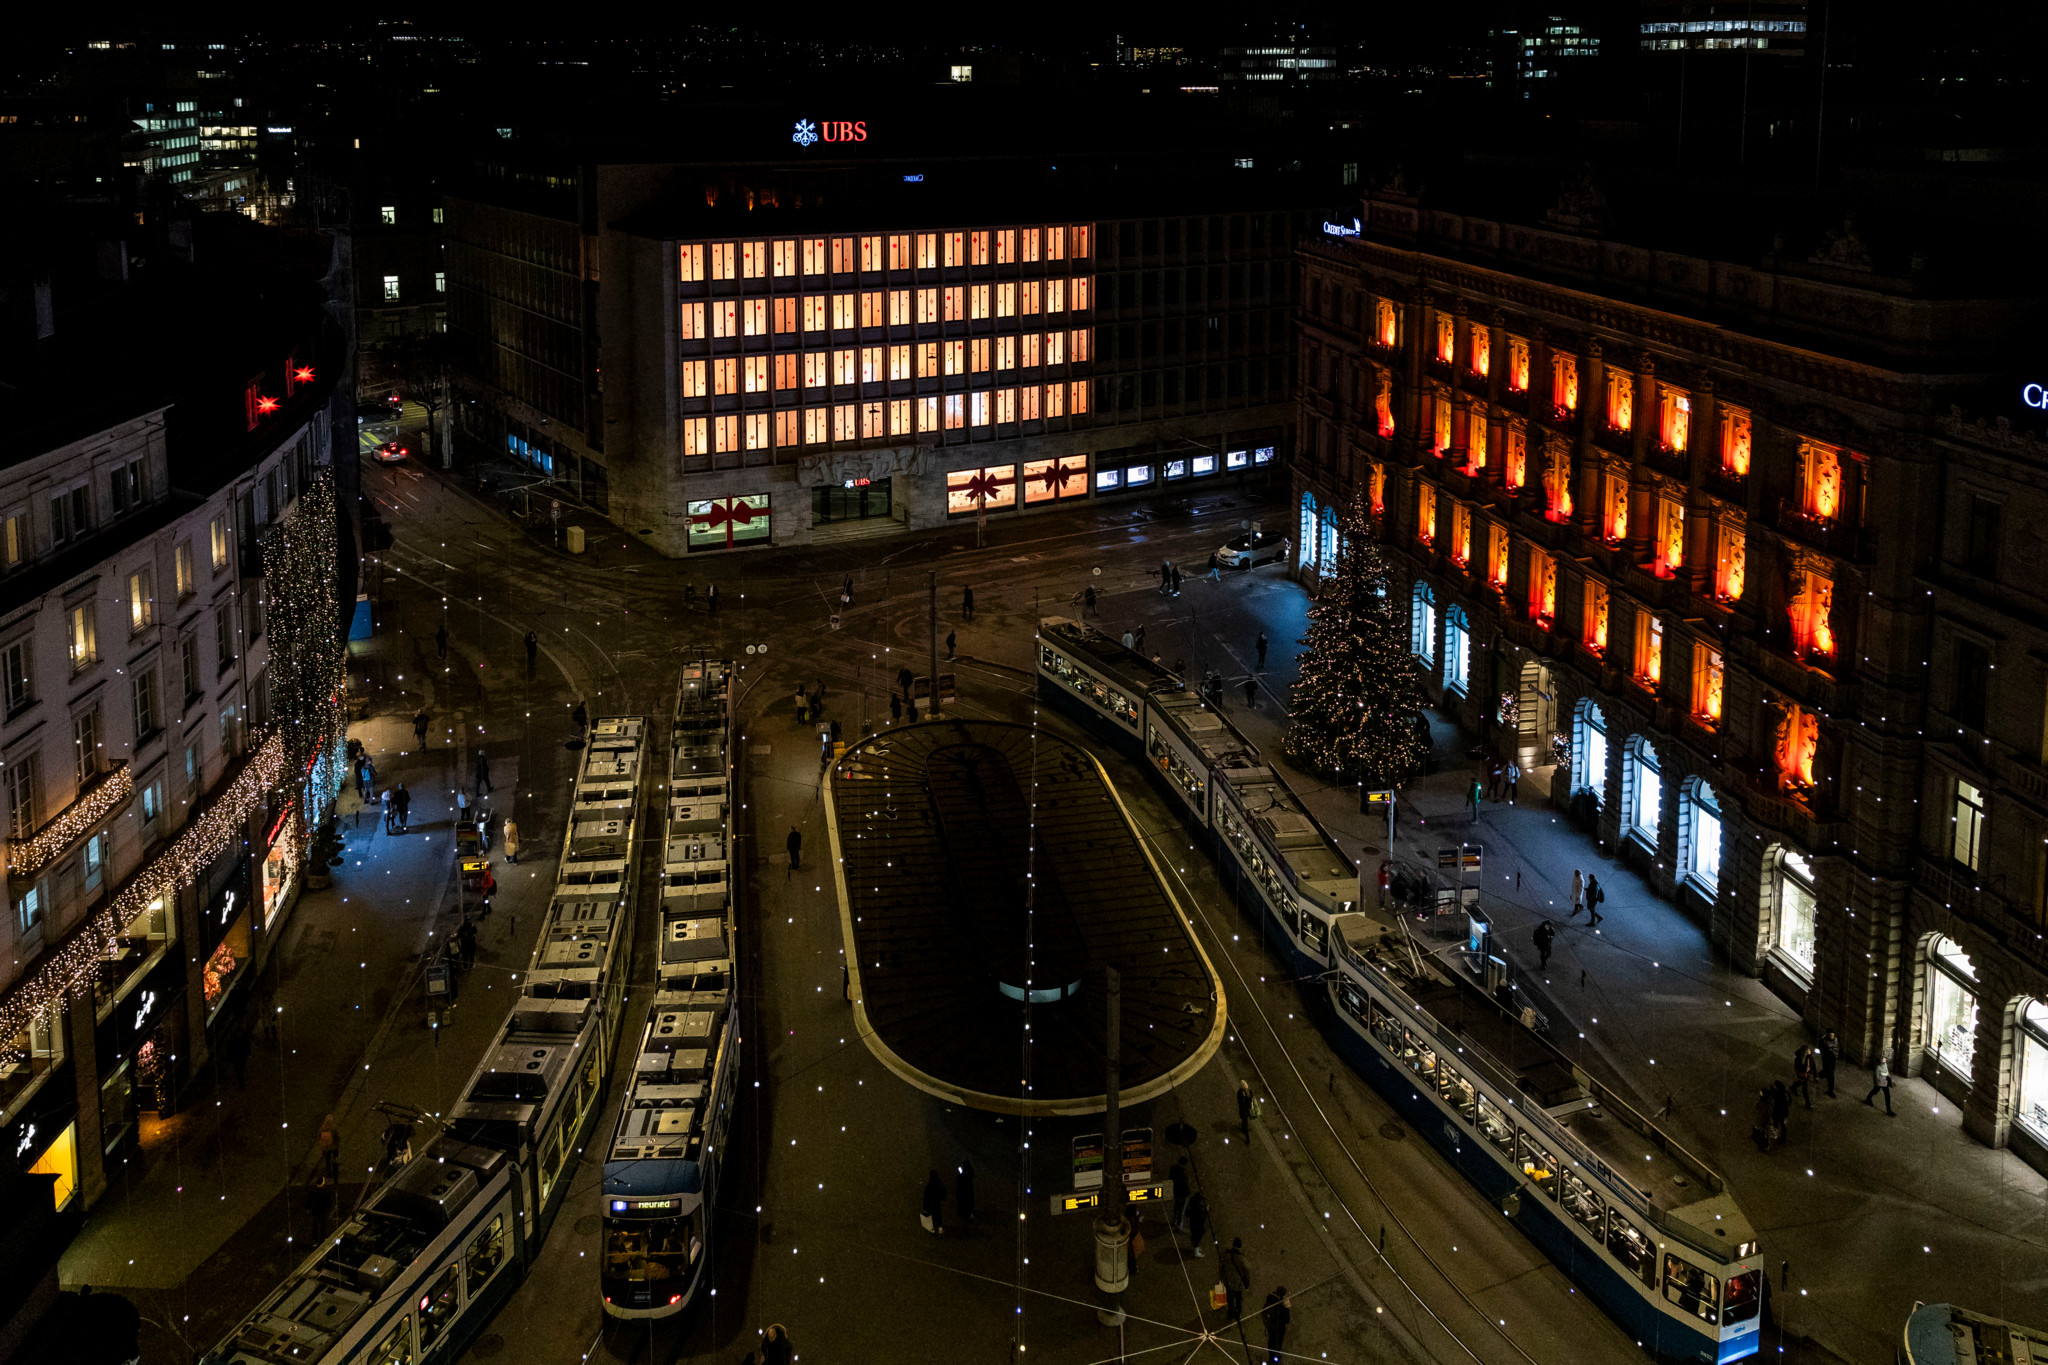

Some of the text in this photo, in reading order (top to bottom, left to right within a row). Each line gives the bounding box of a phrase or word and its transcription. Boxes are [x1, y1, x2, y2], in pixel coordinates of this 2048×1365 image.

[821, 121, 867, 142] UBS
[854, 477, 871, 487] UBS
[1343, 901, 1352, 912] 7
